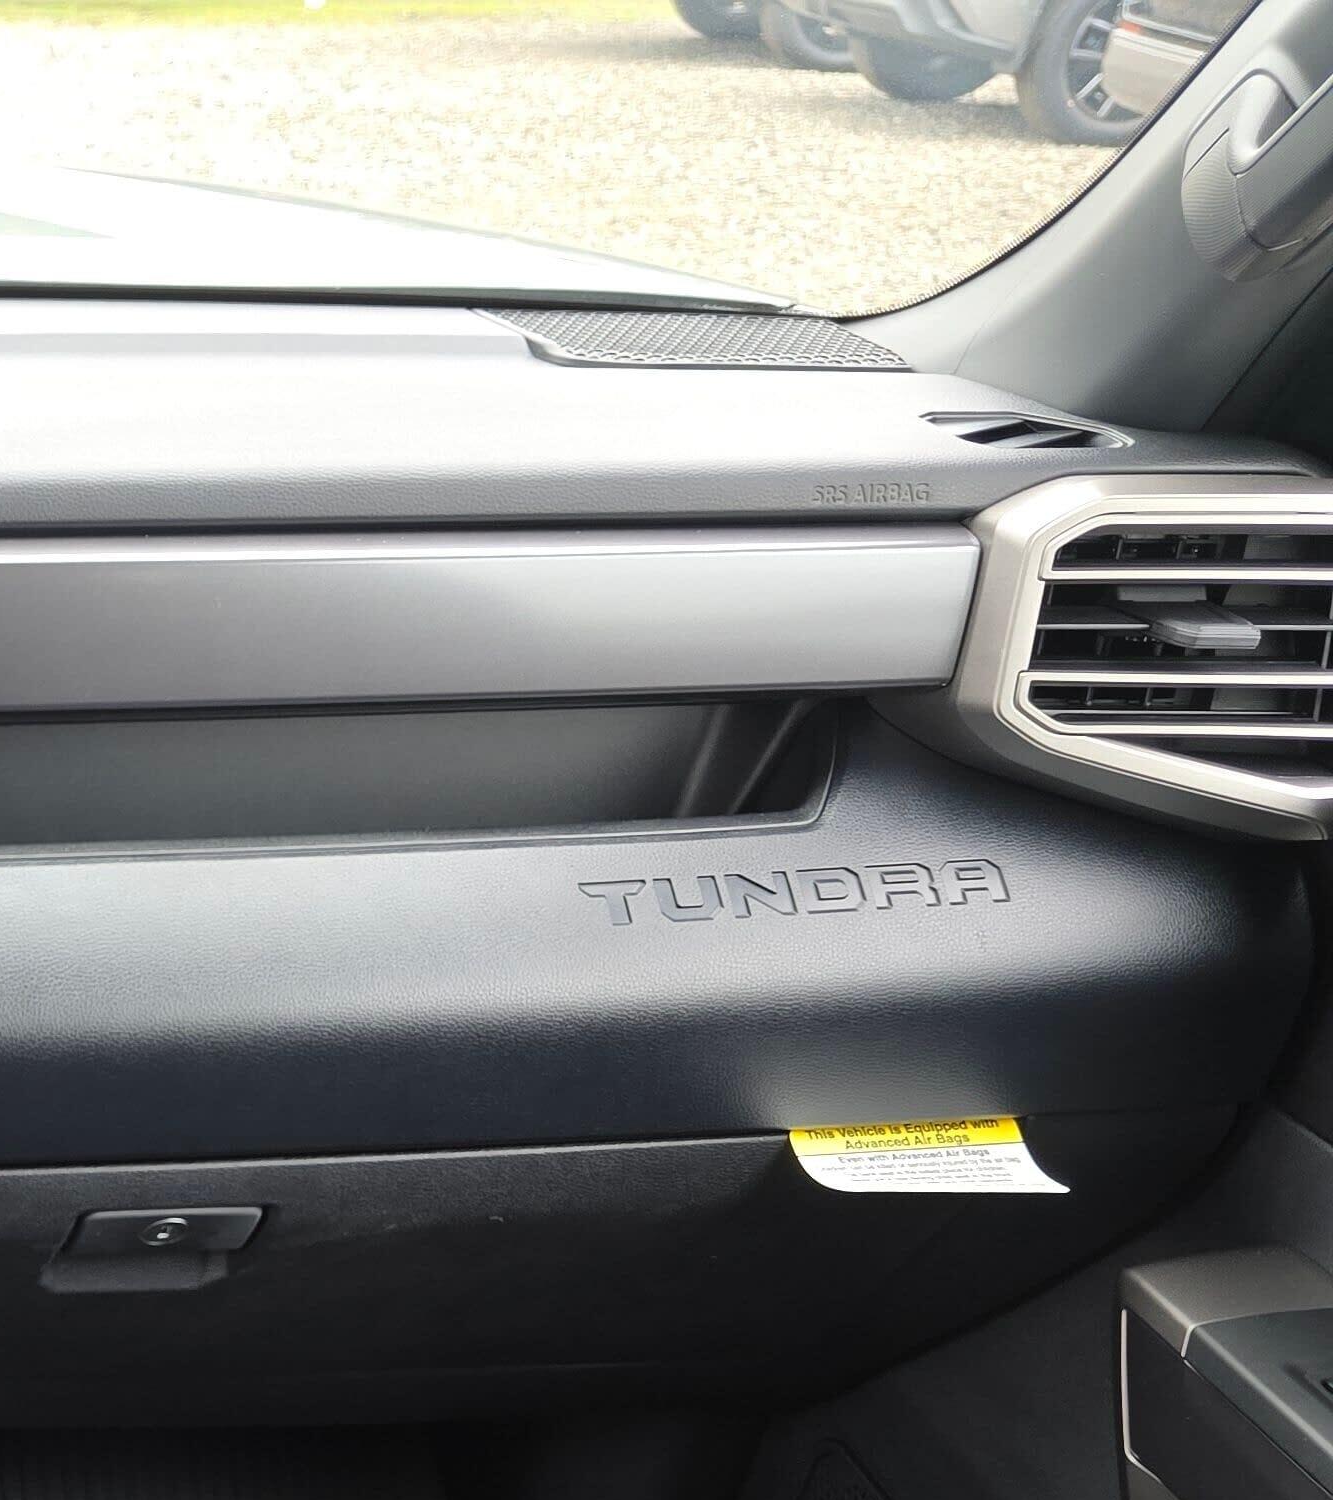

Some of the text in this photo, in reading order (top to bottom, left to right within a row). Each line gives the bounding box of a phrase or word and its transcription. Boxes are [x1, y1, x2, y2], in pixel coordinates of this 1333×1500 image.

[813, 482, 930, 502] SRS AIRBAG
[578, 858, 1011, 926] TUNDRA
[806, 1129, 835, 1140] This
[836, 1125, 887, 1138] Vehicle
[904, 1120, 968, 1138] Equipped
[970, 1118, 1000, 1130] with
[845, 1132, 971, 1150] Advanced Air Bags
[838, 1156, 864, 1164] Even
[868, 1154, 889, 1162] with
[892, 1151, 943, 1161] Advanced
[963, 1148, 990, 1157] Bags
